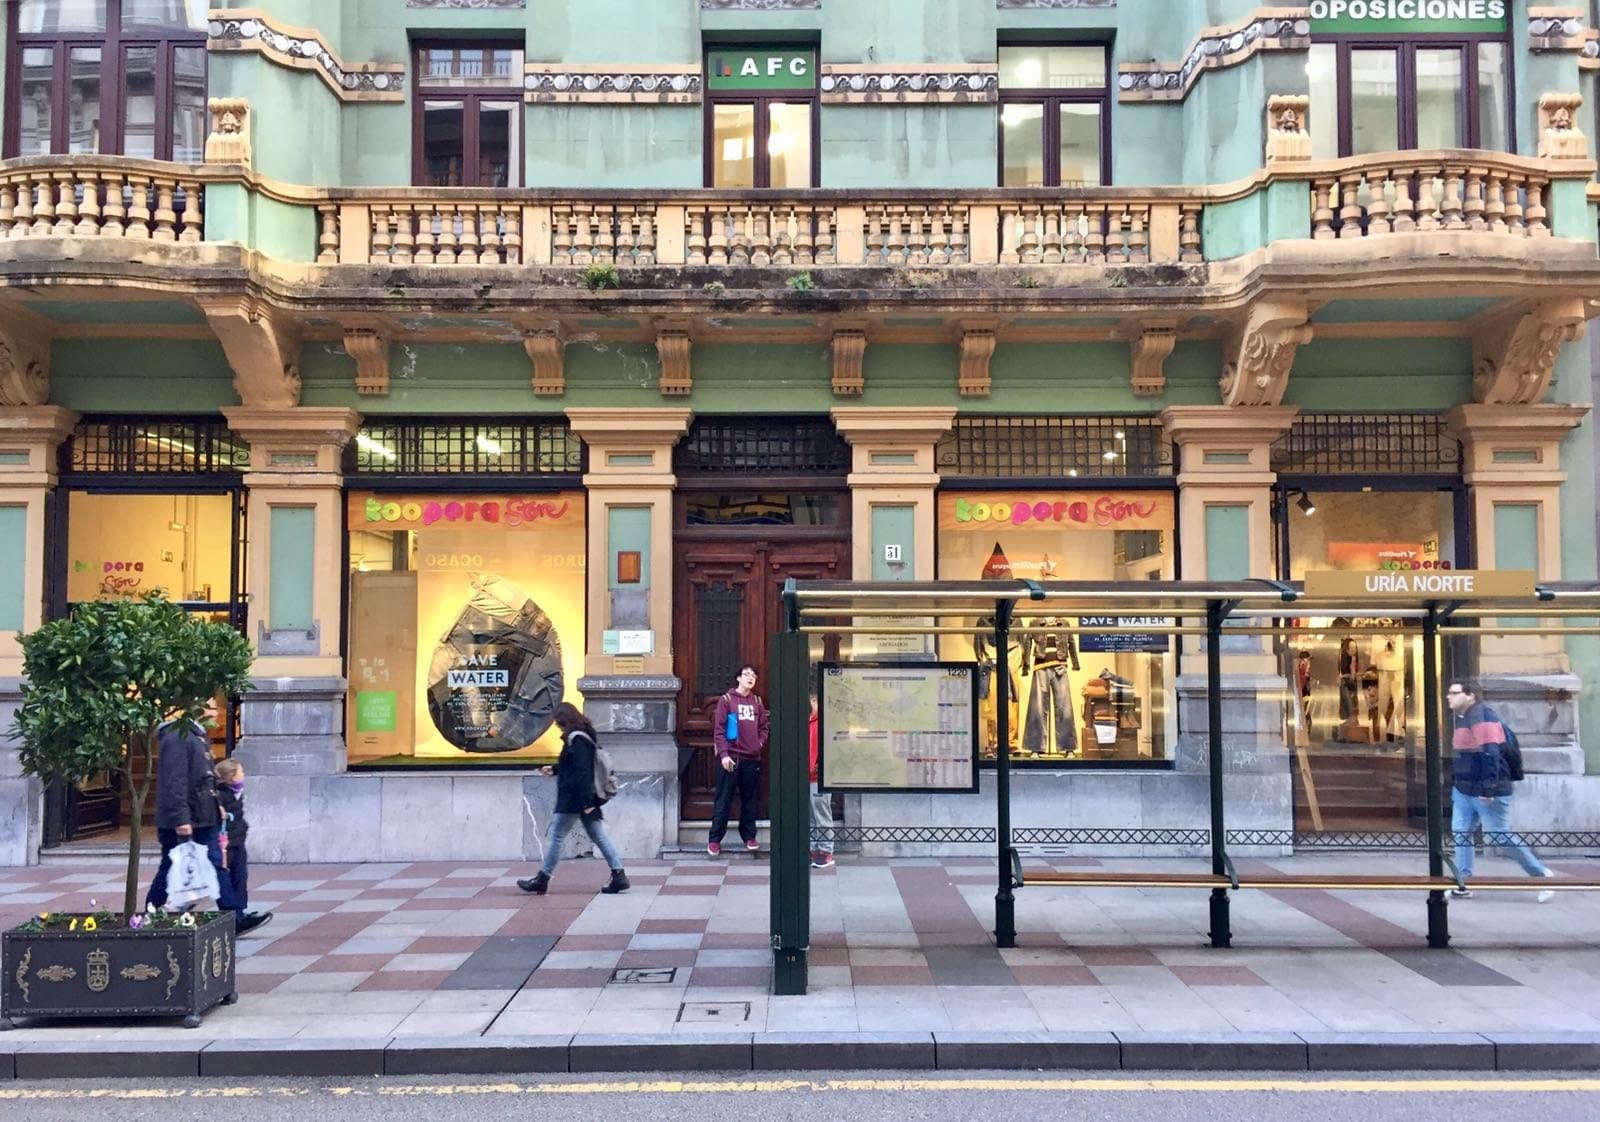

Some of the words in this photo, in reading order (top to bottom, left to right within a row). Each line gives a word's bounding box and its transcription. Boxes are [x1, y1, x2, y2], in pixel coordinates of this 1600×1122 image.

[1310, 0, 1505, 19] OPOSICIONES
[366, 497, 500, 526] koopera
[955, 497, 1089, 526] koopera
[1365, 572, 1409, 592] URÍA
[1413, 575, 1474, 592] NORTE
[1082, 617, 1113, 625] SAVE
[1121, 617, 1165, 625] WATER
[460, 654, 498, 666] SAVE
[451, 671, 505, 684] WATER
[948, 668, 968, 677] 1220
